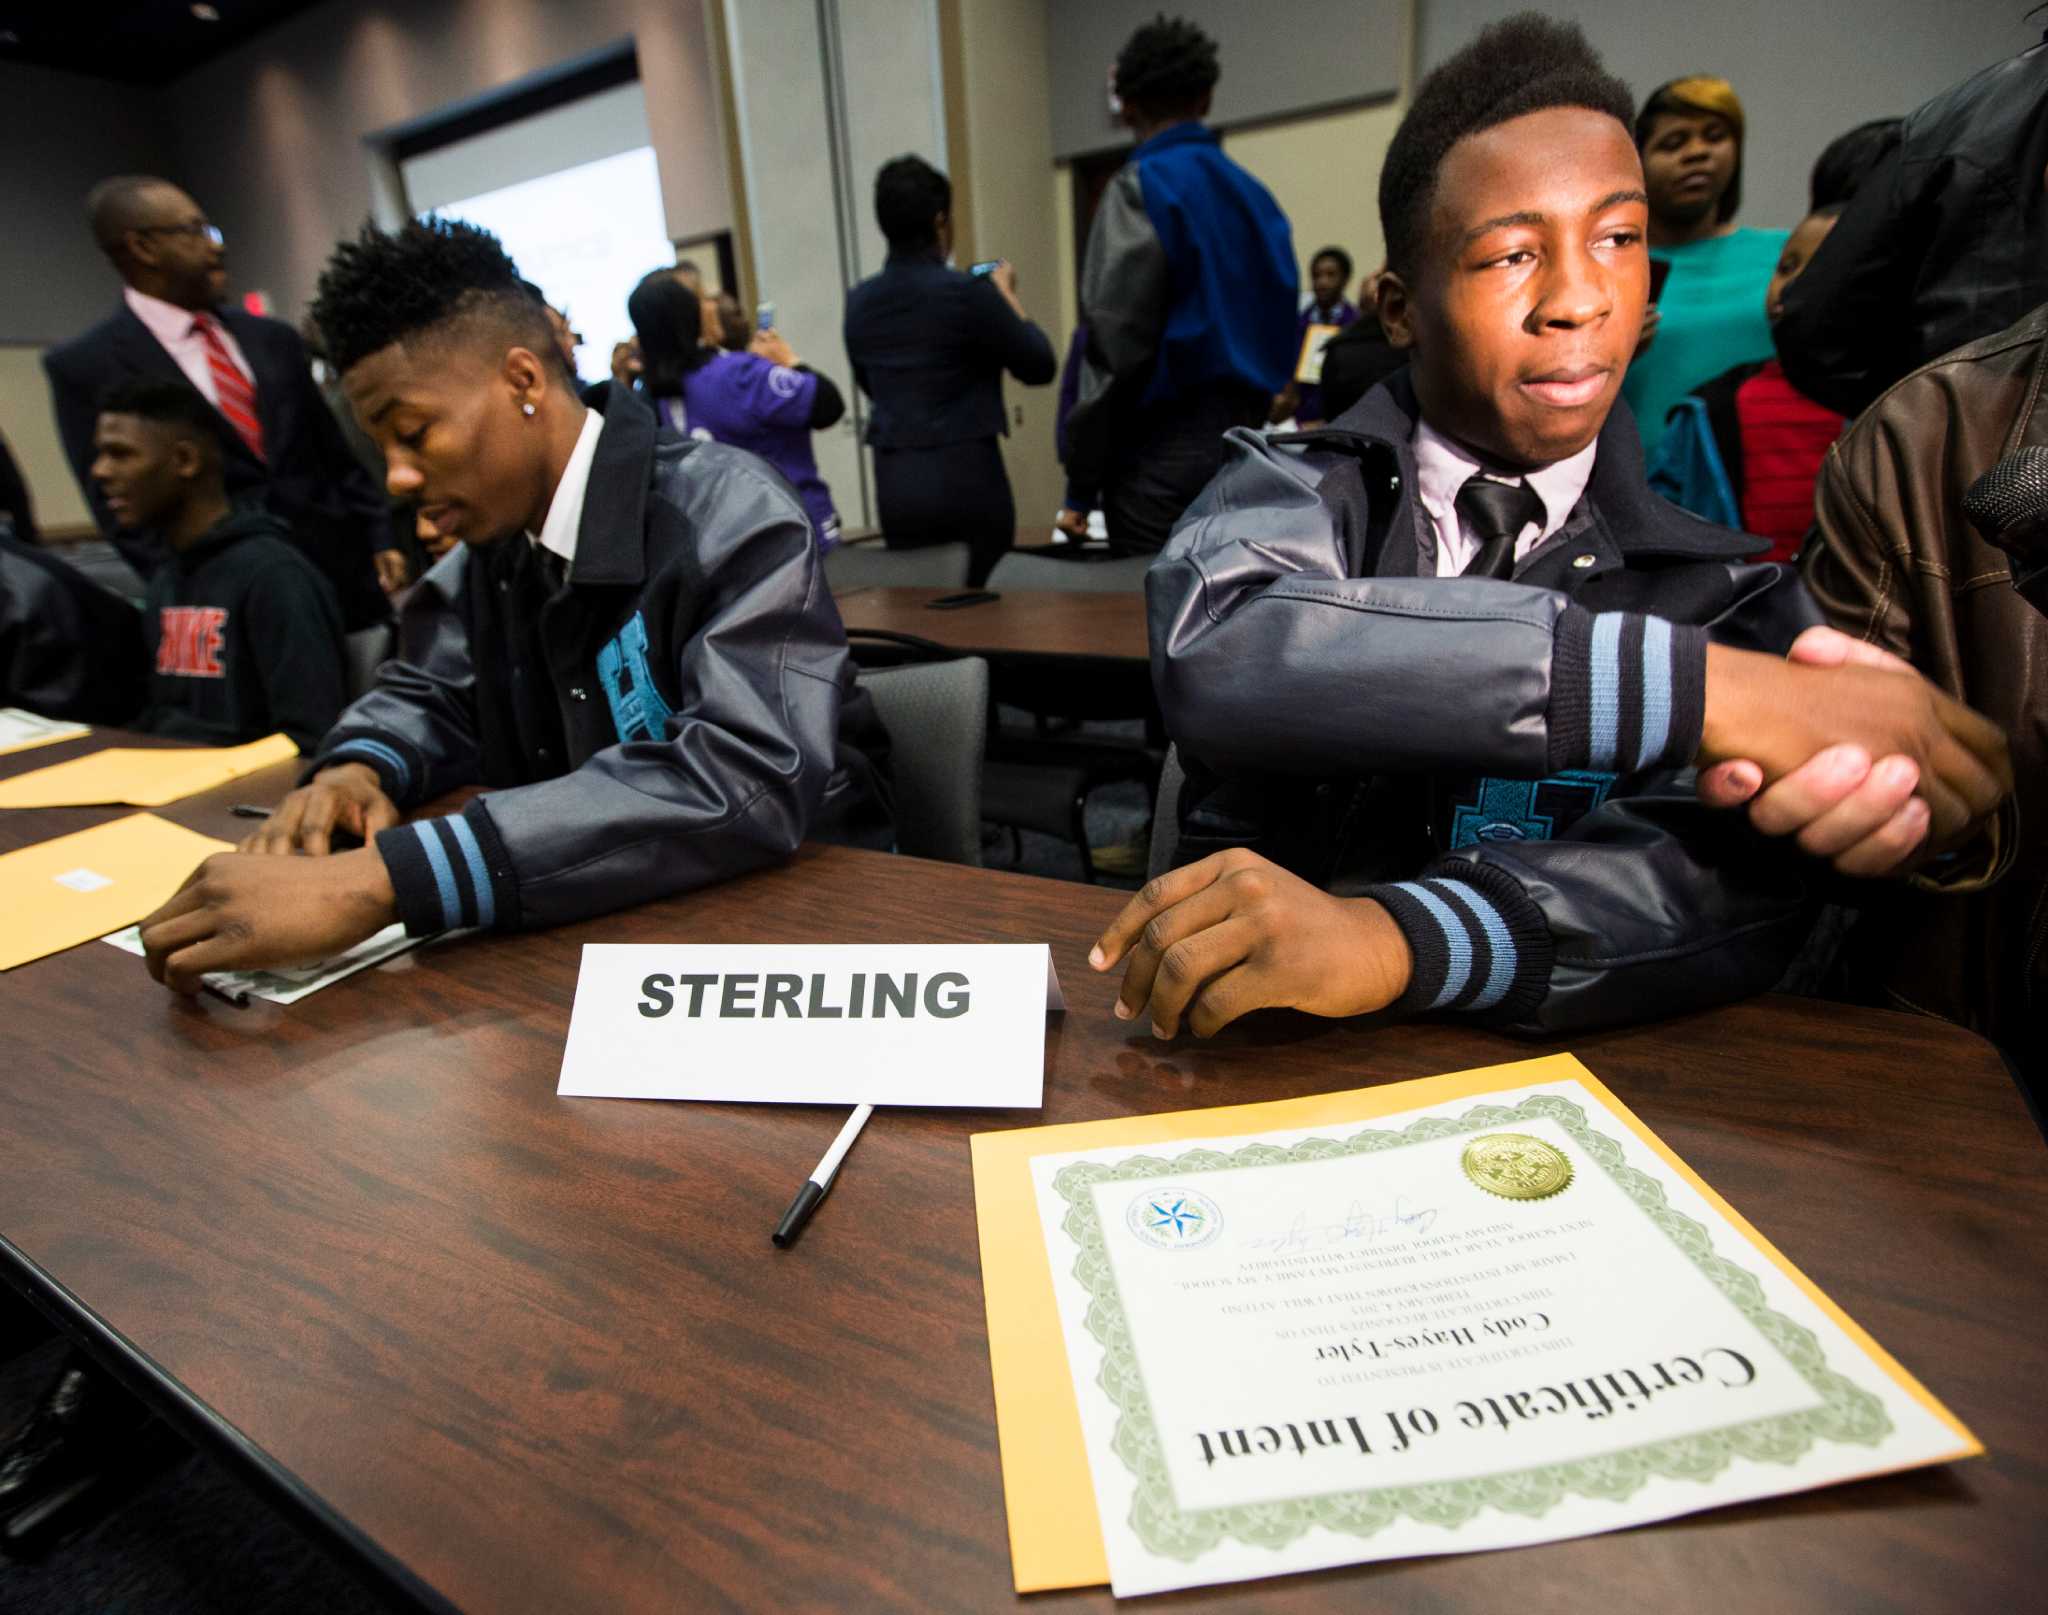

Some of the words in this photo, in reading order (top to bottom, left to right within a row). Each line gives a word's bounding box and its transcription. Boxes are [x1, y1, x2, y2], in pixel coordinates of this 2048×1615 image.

[637, 971, 971, 1020] STERLING
[1397, 1290, 1471, 1309] FEBRUARY
[1482, 1312, 1549, 1337] Cody
[1314, 1328, 1476, 1362] Hayes-Tyler
[1446, 1344, 1539, 1368] CERTIFICATE
[1541, 1336, 1574, 1351] THIS
[1341, 1366, 1425, 1383] PRESENTED
[1453, 1347, 1758, 1434] Certificate
[1192, 1415, 1374, 1470] Intent
[1382, 1407, 1440, 1453] of
